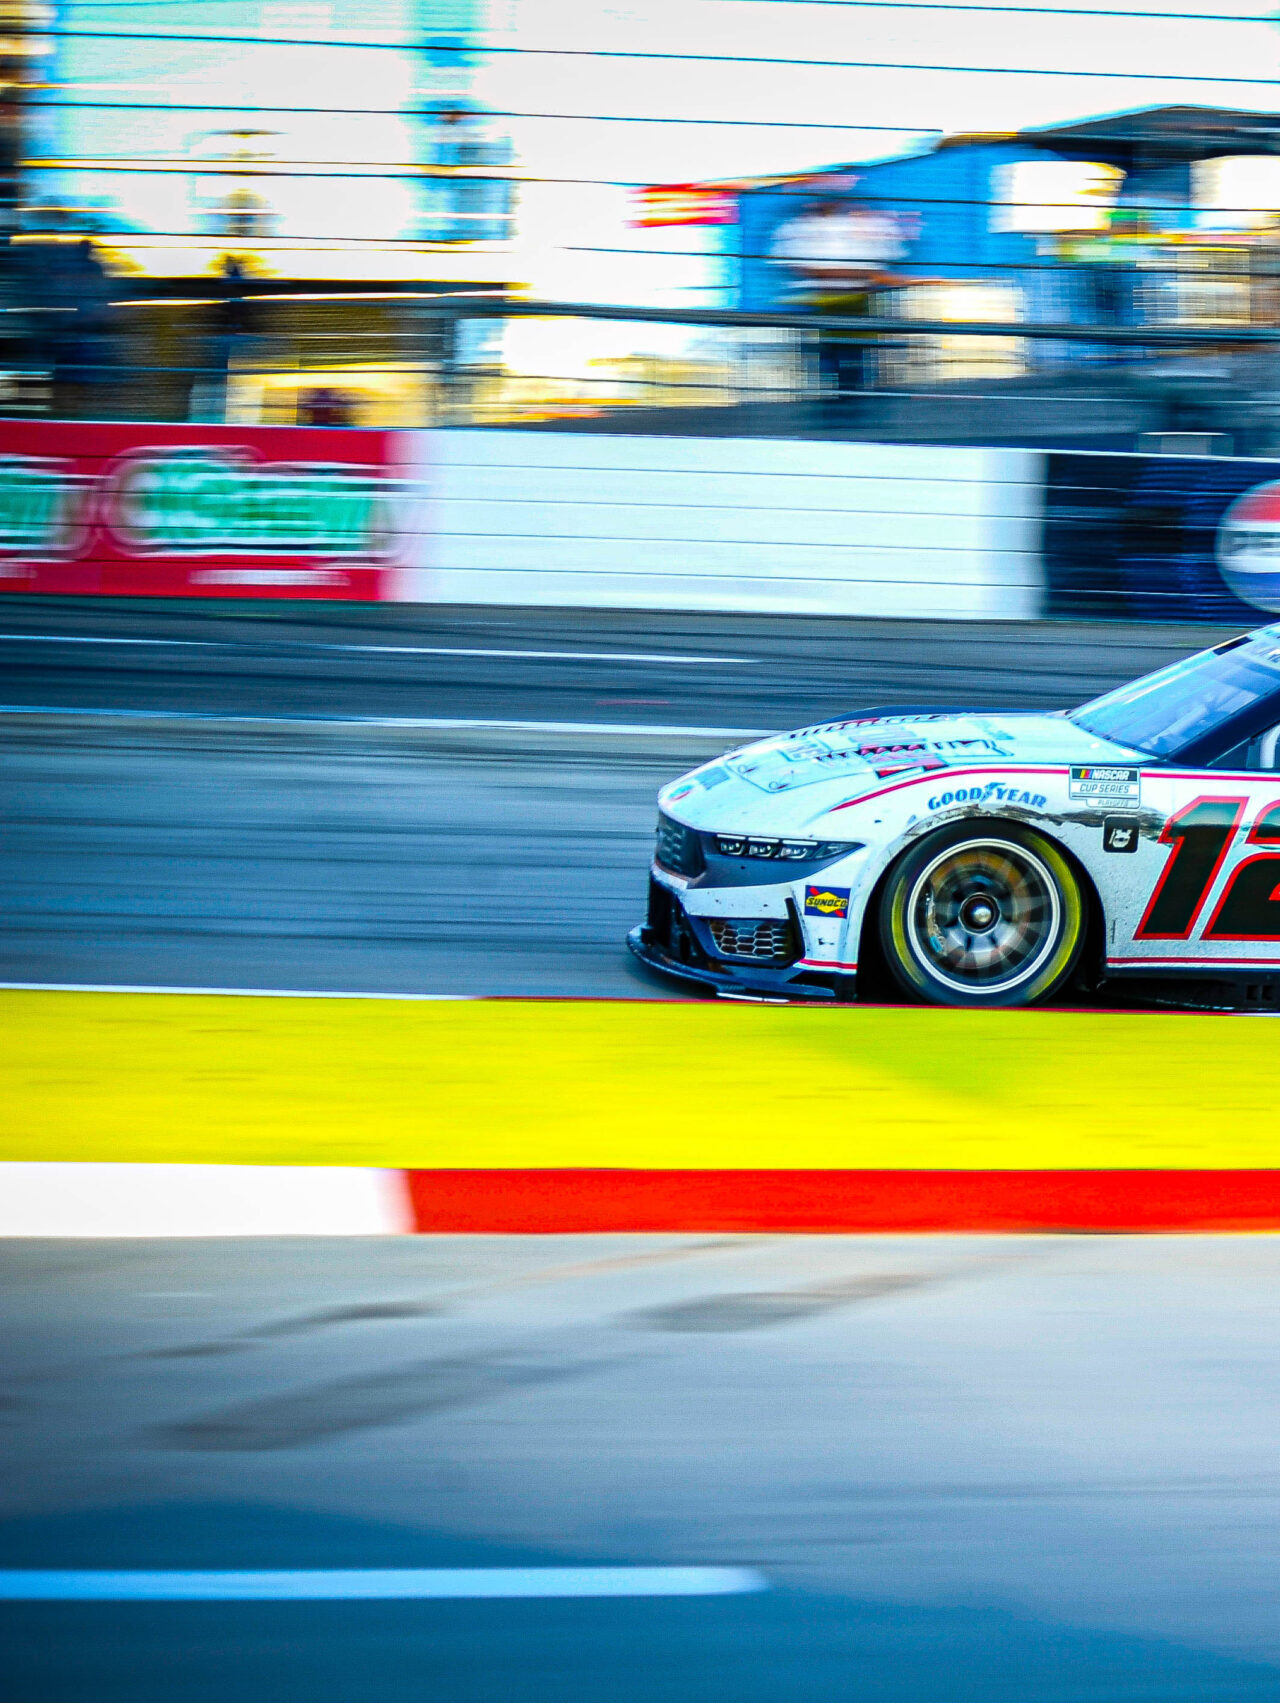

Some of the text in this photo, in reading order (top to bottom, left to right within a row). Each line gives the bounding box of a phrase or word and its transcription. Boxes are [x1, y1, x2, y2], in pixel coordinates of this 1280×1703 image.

[1092, 769, 1130, 780] NASCAR
[1080, 784, 1130, 793] CUP SERIES
[928, 783, 1047, 810] GOODYEAR
[807, 897, 848, 908] SUNOCO
